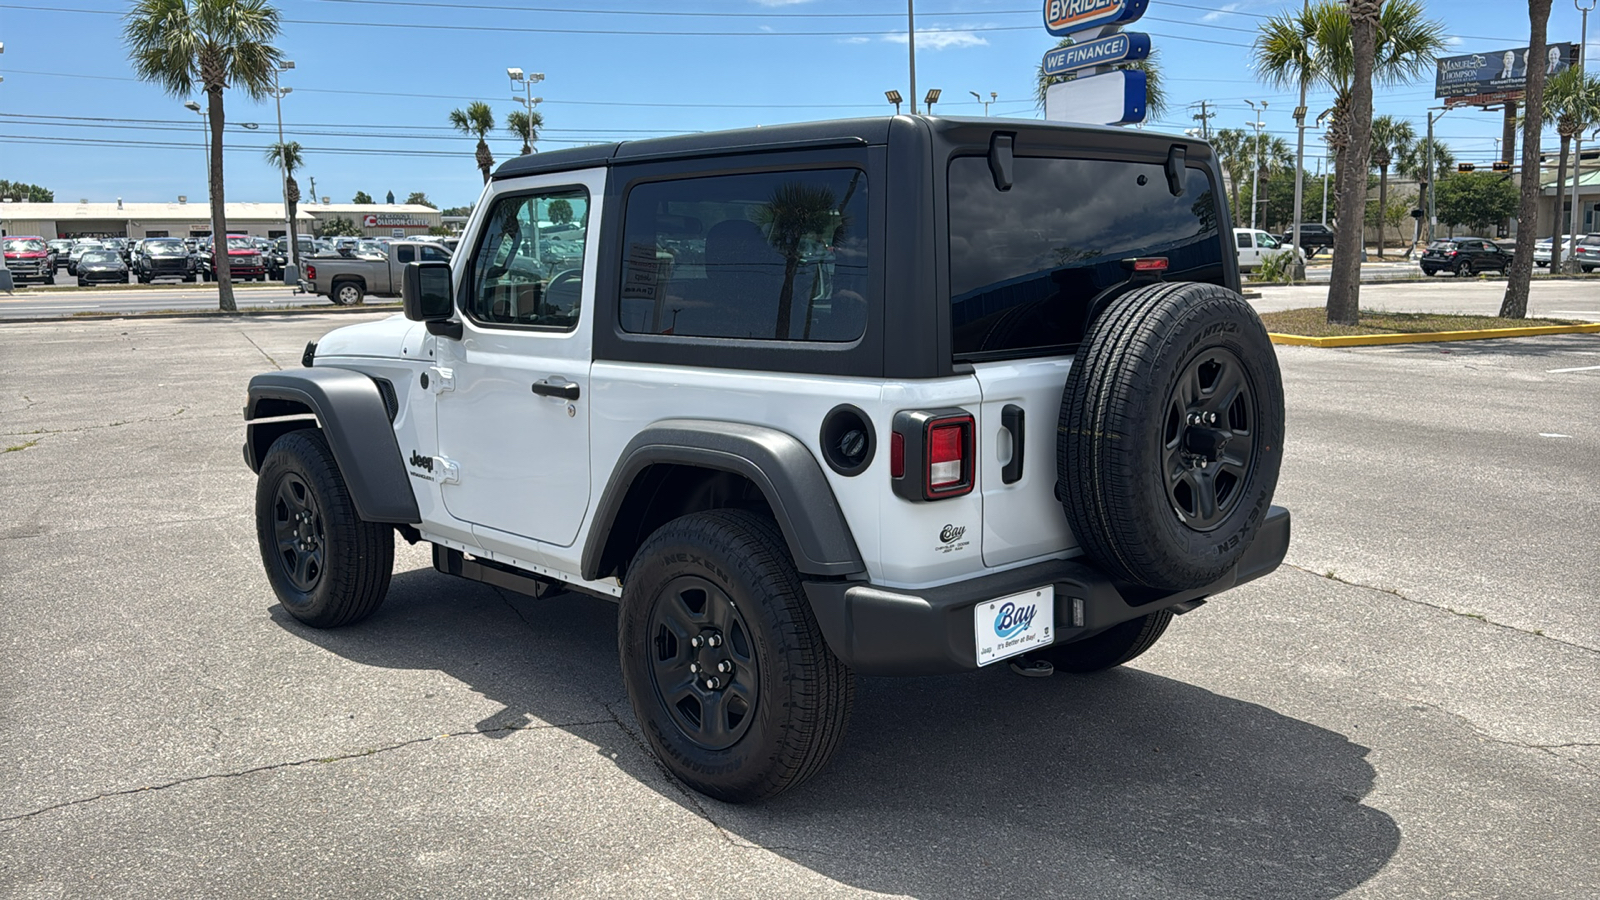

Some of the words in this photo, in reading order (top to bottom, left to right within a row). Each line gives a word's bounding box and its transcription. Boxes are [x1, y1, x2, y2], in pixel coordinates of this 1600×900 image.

[1049, 0, 1120, 21] BYRID
[1047, 54, 1065, 69] WE
[1066, 39, 1124, 64] FINANCE!
[1441, 69, 1478, 81] THOMPSON
[1442, 60, 1472, 71] MANUEL
[409, 449, 434, 473] Jeep
[940, 523, 966, 542] Bay
[1217, 489, 1267, 555] NEXEN
[662, 552, 729, 584] NEXEN
[997, 601, 1038, 631] Bay
[980, 646, 992, 655] Jeep
[1004, 638, 1020, 648] Better
[1025, 633, 1037, 642] Bay!
